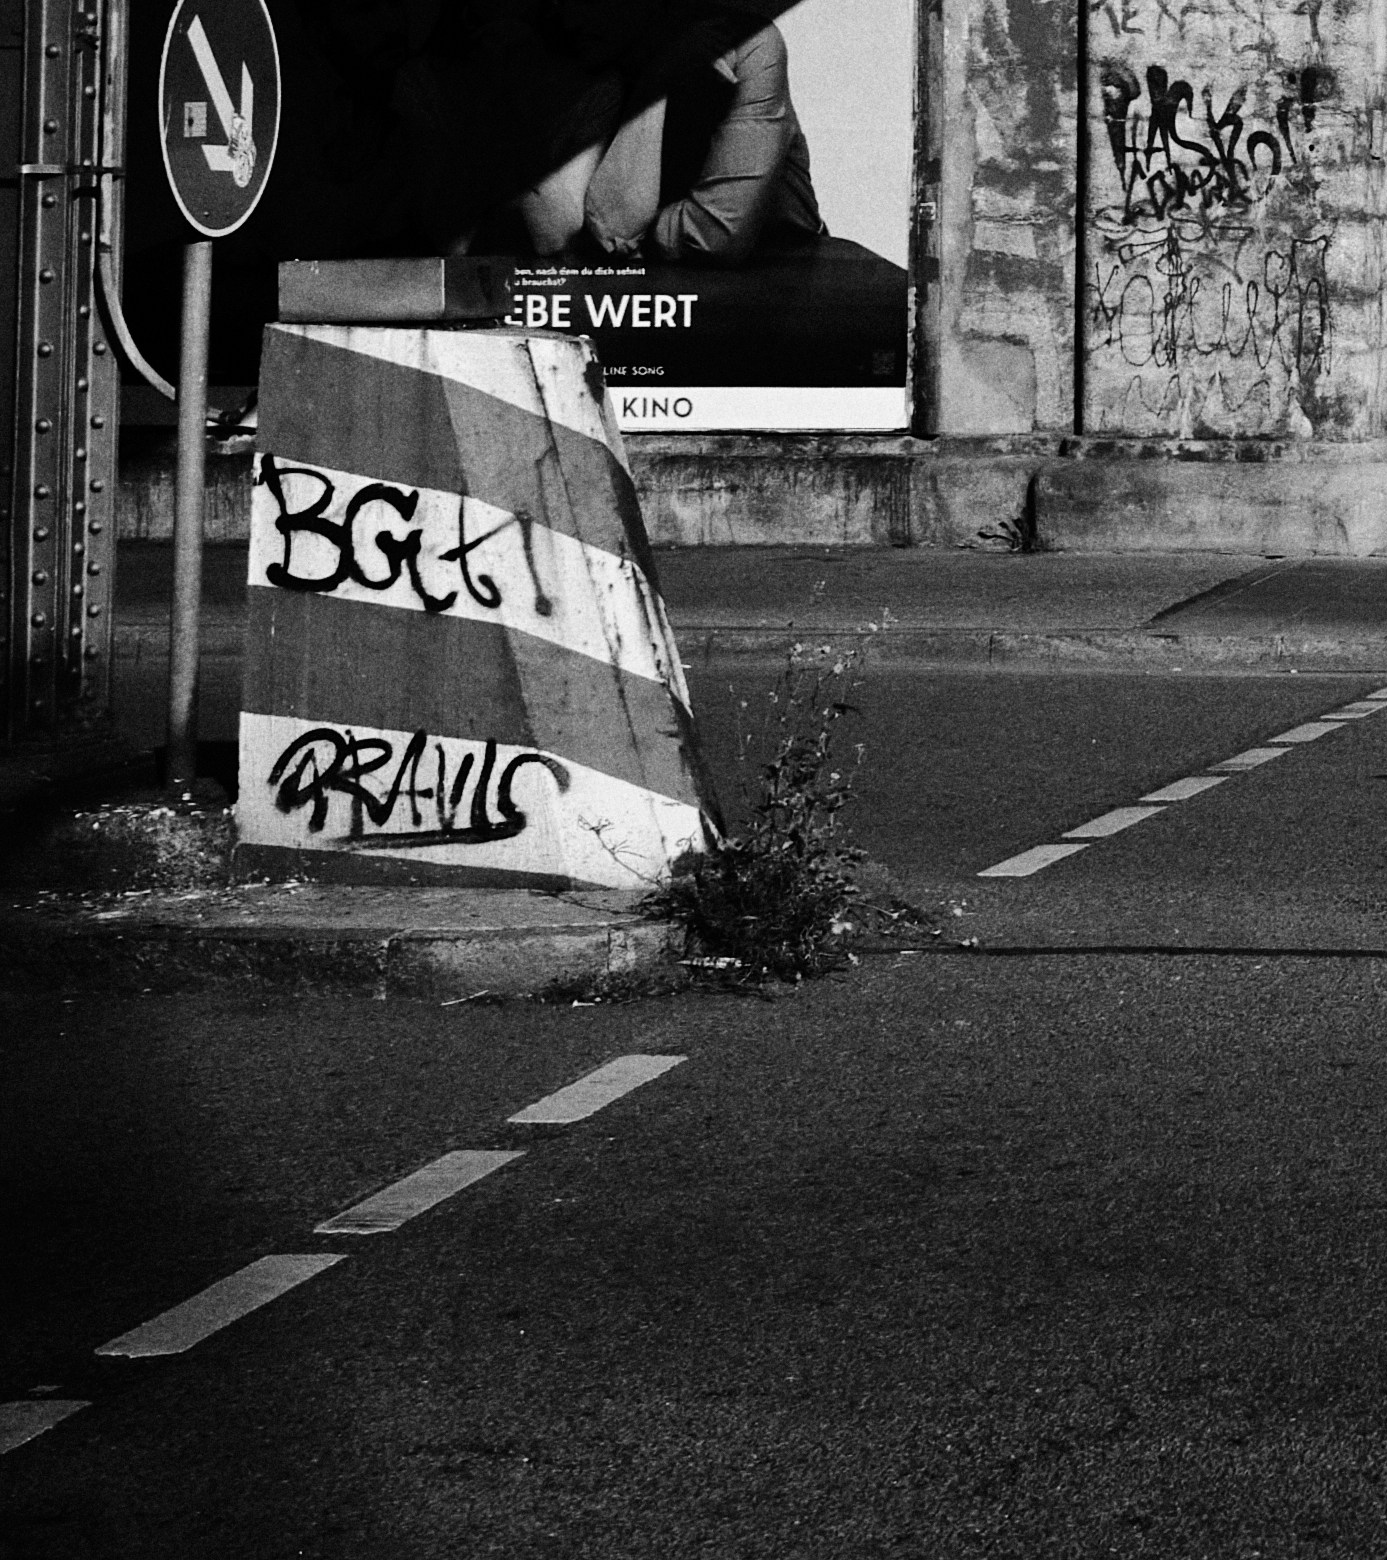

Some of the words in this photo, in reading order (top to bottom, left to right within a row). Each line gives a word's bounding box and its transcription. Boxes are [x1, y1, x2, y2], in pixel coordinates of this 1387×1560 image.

[584, 294, 699, 328] WERT
[631, 366, 665, 376] SONG
[623, 396, 693, 418] KINO
